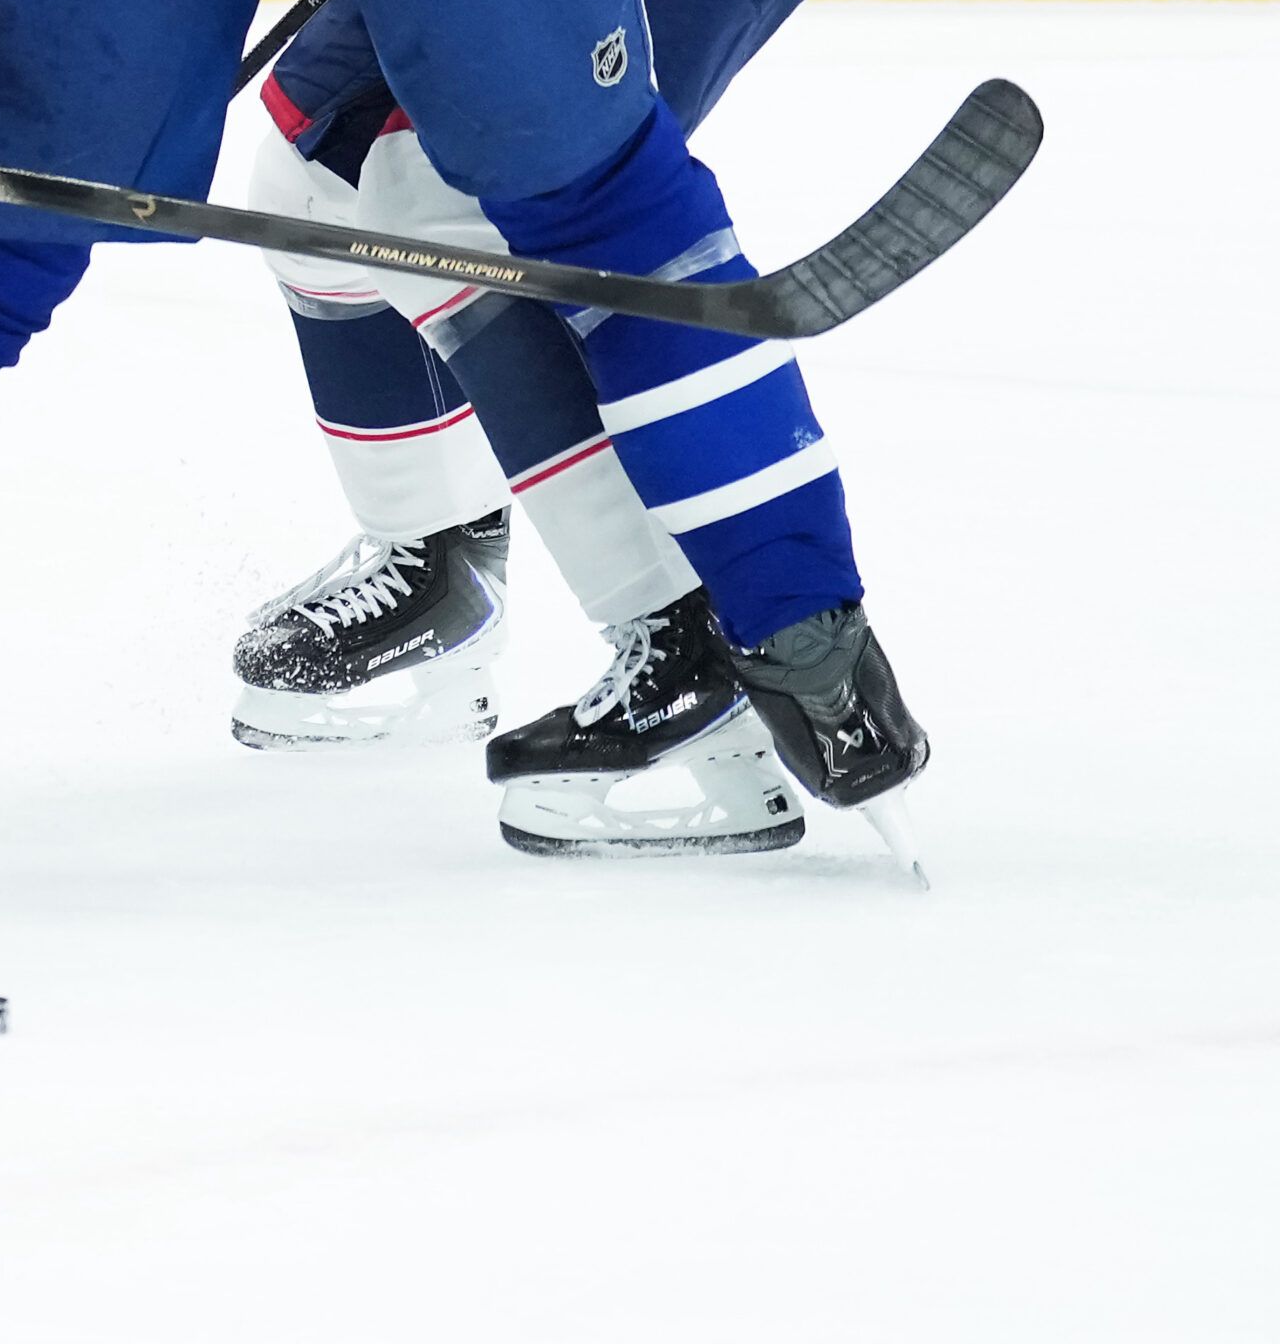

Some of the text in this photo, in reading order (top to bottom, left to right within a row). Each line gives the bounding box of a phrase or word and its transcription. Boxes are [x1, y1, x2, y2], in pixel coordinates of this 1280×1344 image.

[349, 241, 526, 283] ULTRALOW KICKPOINT
[366, 629, 435, 671] BAUER
